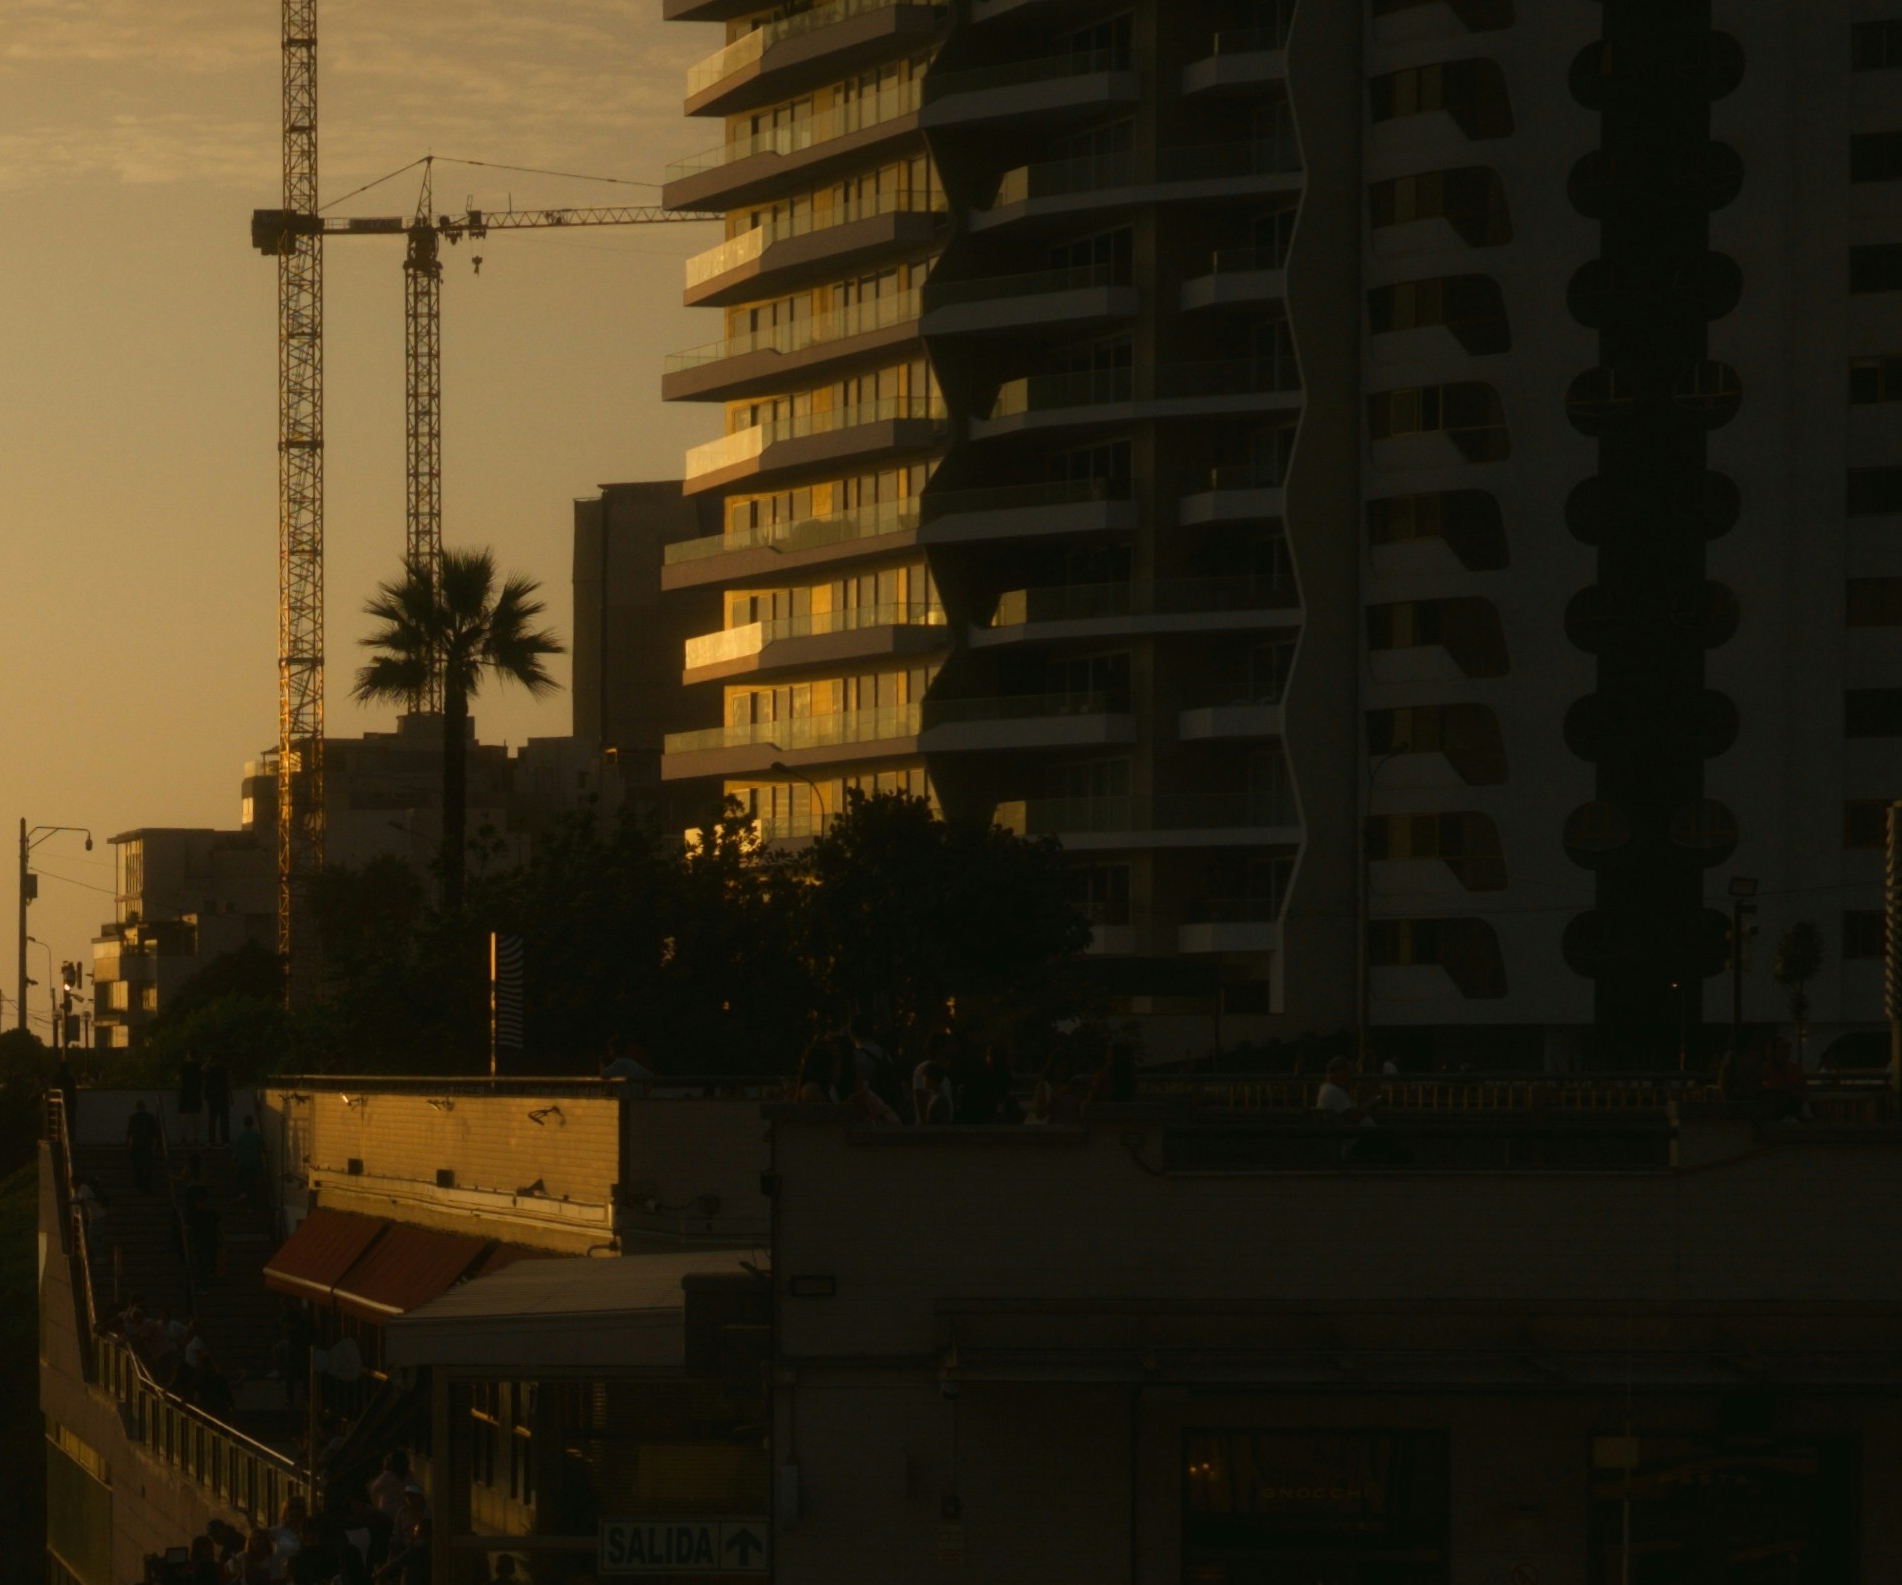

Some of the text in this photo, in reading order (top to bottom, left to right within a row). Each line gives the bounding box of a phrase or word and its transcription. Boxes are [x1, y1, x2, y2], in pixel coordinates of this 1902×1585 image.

[1659, 1473, 1748, 1485] PASTA
[1262, 1487, 1370, 1500] GNOCCHI
[608, 1526, 714, 1565] SALIDA
